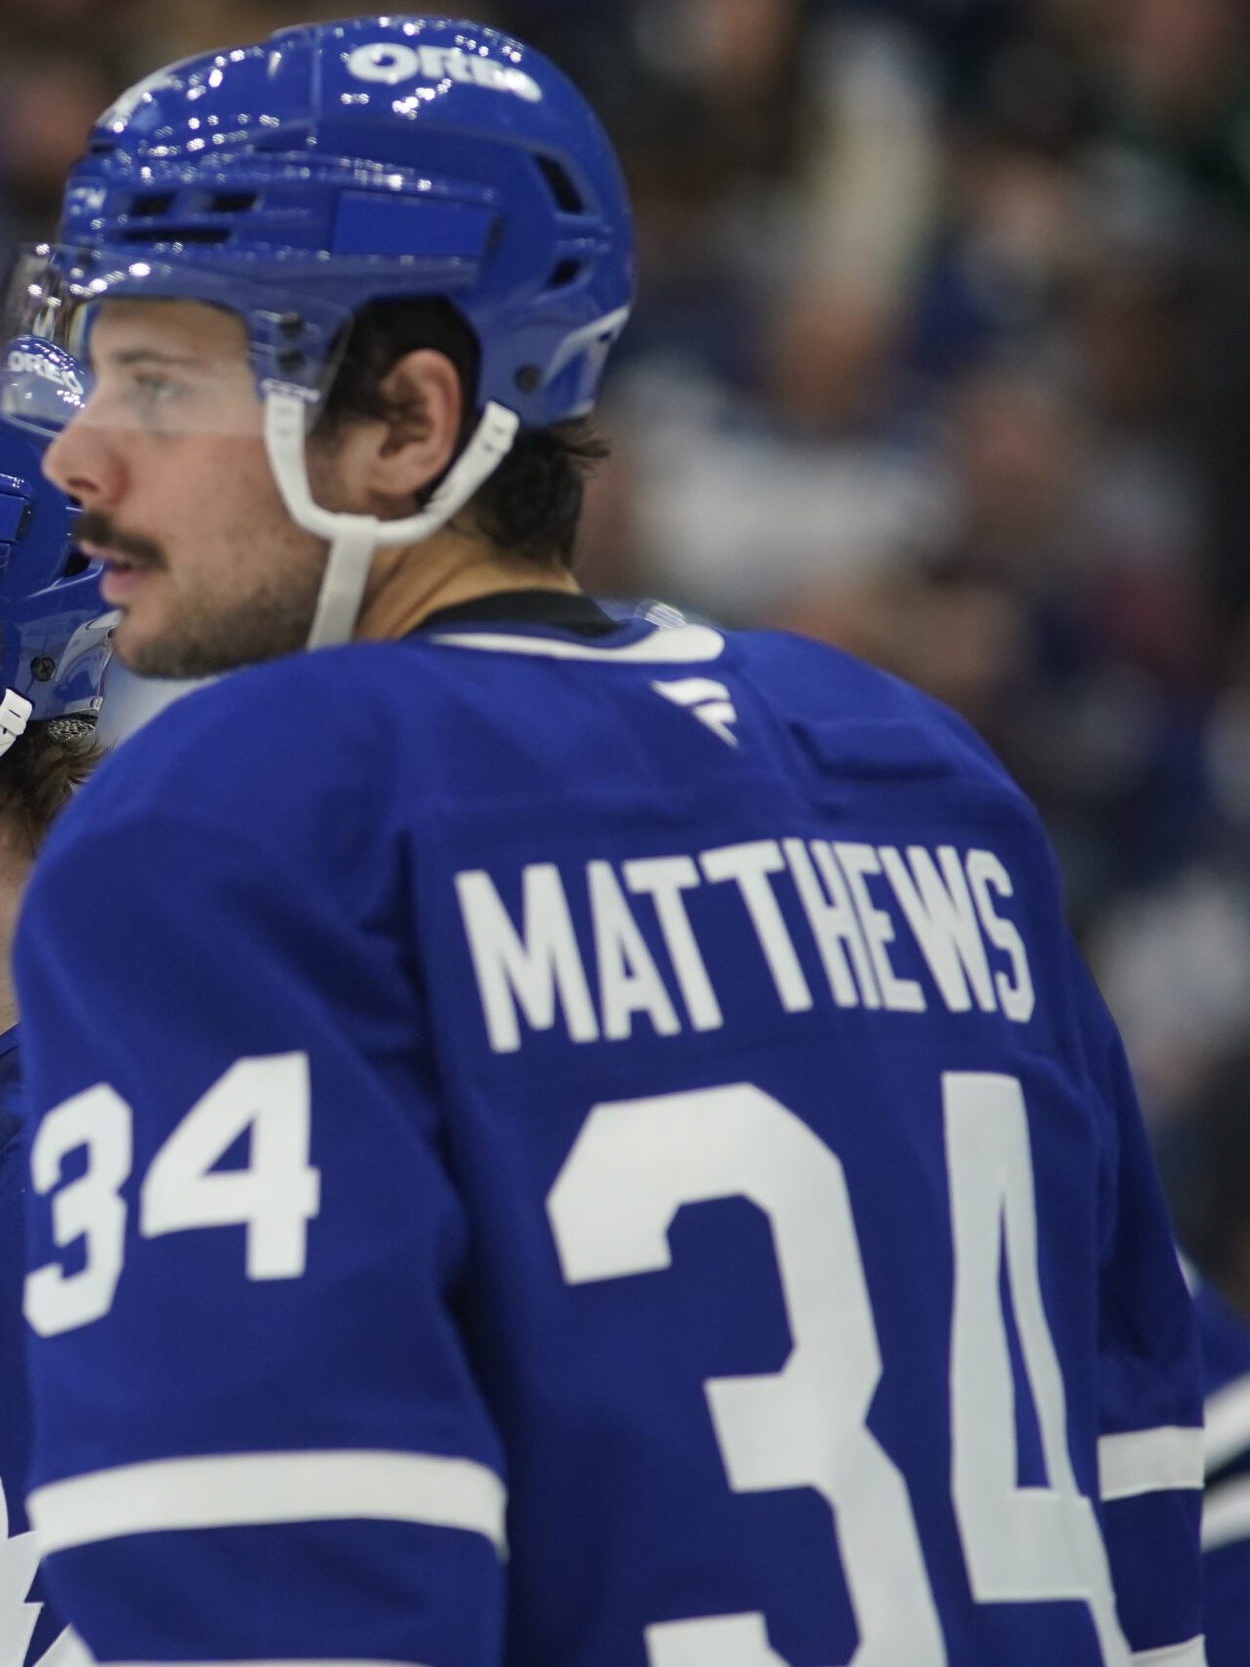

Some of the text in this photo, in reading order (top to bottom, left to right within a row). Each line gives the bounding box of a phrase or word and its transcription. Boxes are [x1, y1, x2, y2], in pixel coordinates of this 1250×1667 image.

[455, 838, 1036, 1053] MATTHEWS
[23, 1048, 321, 1338] 34
[546, 1072, 1132, 1667] 34
